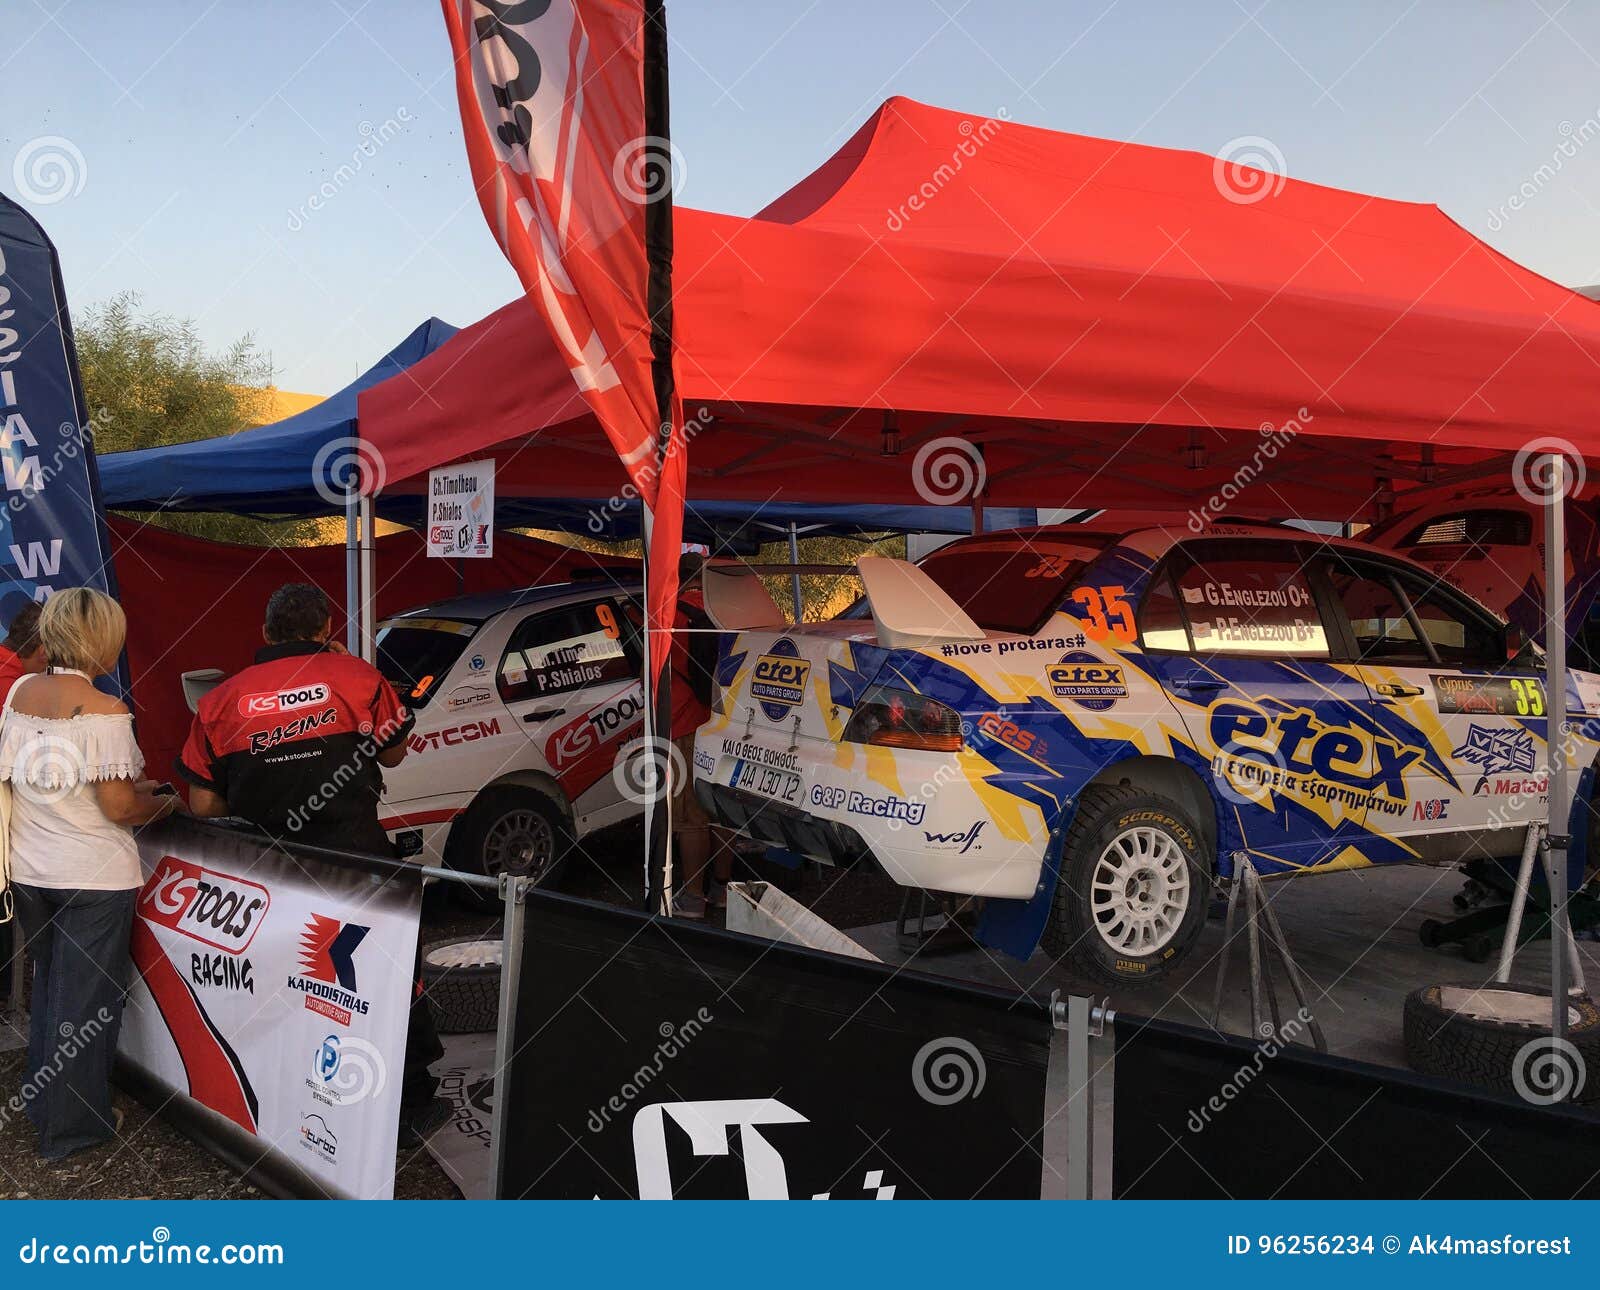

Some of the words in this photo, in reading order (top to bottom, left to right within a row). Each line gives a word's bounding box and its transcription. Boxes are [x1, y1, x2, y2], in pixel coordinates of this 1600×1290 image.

[432, 502, 462, 521] P.Shialos
[1024, 554, 1071, 579] 35
[595, 604, 620, 640] 9
[1071, 585, 1138, 644] 35
[941, 641, 992, 657] #love
[999, 633, 1087, 656] protaras#
[411, 675, 435, 699] 9
[537, 666, 602, 691] P.Shialos
[755, 660, 809, 686] etex
[1050, 667, 1121, 684] etex
[1437, 676, 1475, 696] Cyprus
[752, 683, 766, 694] AUTO
[765, 686, 783, 698] PARTS
[782, 690, 802, 701] GROUP
[1056, 687, 1077, 695] AUTO
[1077, 687, 1101, 695] PARTS
[1101, 687, 1125, 695] GROUP
[1510, 678, 1544, 717] 35
[247, 708, 337, 755] RACING
[404, 717, 501, 754] ETCOM
[264, 750, 323, 764] www.kstools.eu
[1209, 702, 1424, 801] etex
[739, 763, 757, 788] AA
[758, 768, 782, 797] 130
[781, 775, 801, 801] 12
[1228, 761, 1297, 791] εταιρεία
[1301, 778, 1408, 817] εξαρτημάτων
[1494, 777, 1550, 796] Matad
[810, 784, 847, 810] G&P
[847, 787, 927, 826] Racing
[1118, 811, 1196, 851] SCORPION
[191, 952, 254, 996] RACING
[287, 975, 370, 1016] KAPODISTRIAS
[305, 997, 337, 1018] AUTOMOTIVE
[334, 1006, 350, 1025] PARTS
[300, 1125, 337, 1156] 4turbo
